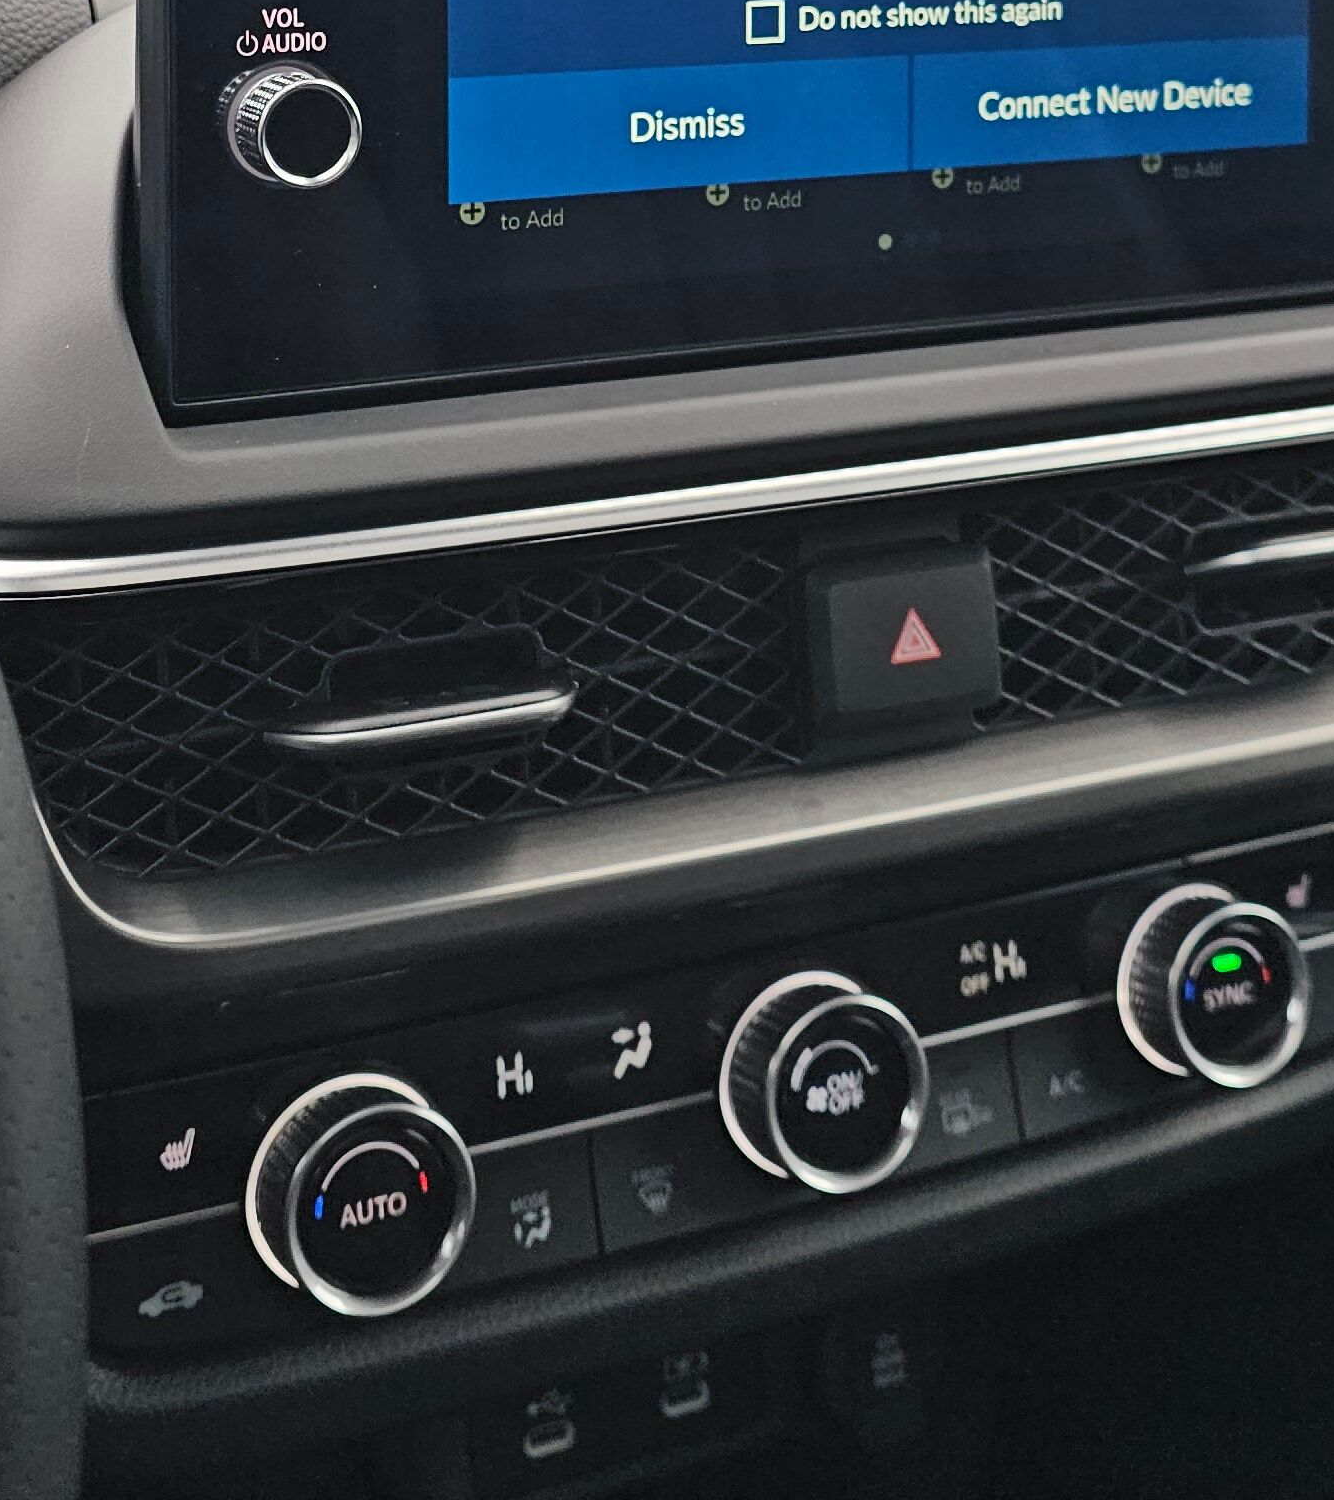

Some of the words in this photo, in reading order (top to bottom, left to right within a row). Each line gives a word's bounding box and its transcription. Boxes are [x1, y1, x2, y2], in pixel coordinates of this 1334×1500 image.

[261, 7, 305, 29] VOL
[798, 5, 836, 32] Do
[840, 4, 882, 30] not
[885, 1, 951, 28] show
[261, 31, 327, 54] AUDIO
[978, 87, 1092, 122] Connect
[1096, 83, 1160, 115] New
[1162, 77, 1253, 111] Device
[630, 106, 746, 144] Dismiss
[1171, 163, 1192, 180] to
[1193, 159, 1224, 178] Add
[966, 179, 984, 195] to
[987, 173, 1021, 193] Add
[743, 194, 762, 212] to
[766, 189, 802, 210] Add
[500, 213, 521, 231] to
[525, 207, 564, 229] Add
[1202, 980, 1253, 1012] SYNC
[340, 1191, 407, 1229] AUTO
